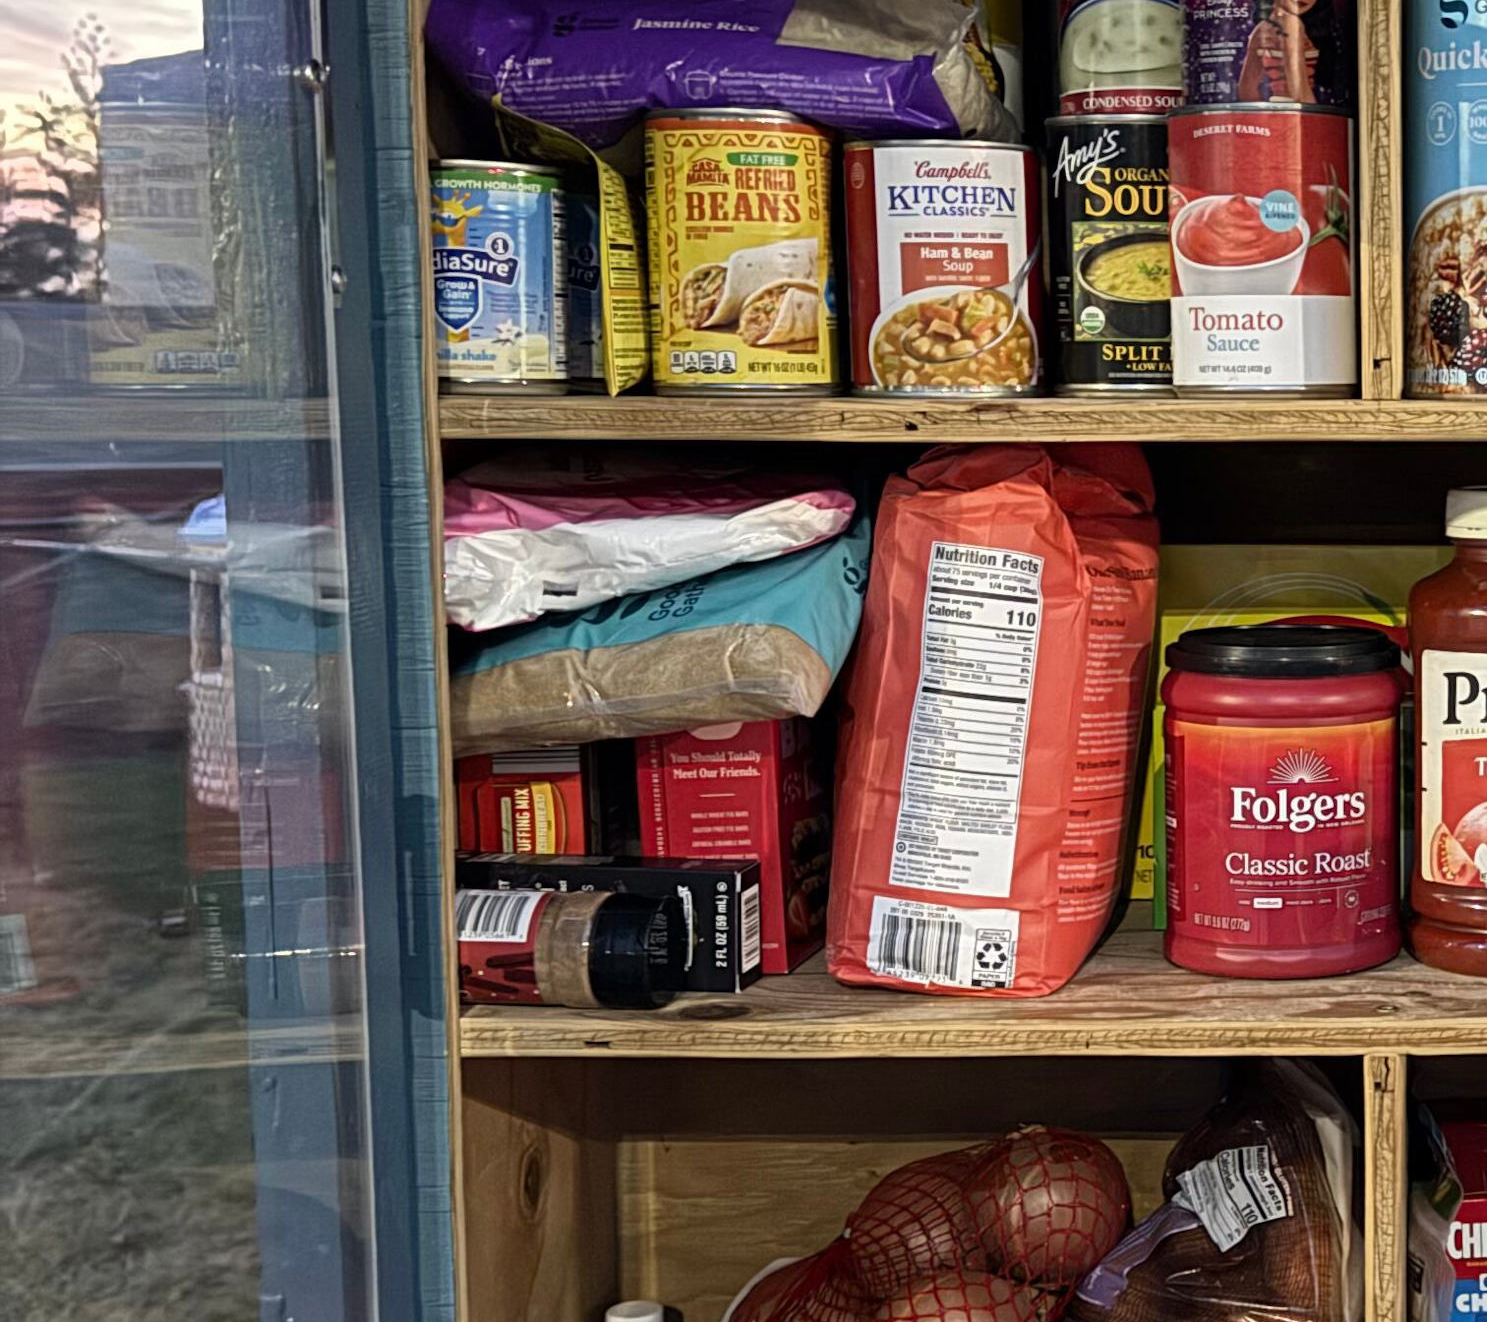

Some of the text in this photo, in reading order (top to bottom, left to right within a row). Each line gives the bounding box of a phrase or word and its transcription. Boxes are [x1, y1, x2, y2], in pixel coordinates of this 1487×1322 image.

[1193, 6, 1249, 20] PRINCESS
[632, 17, 761, 33] Jasmine Rice
[1083, 95, 1151, 110] CONDENSED
[1193, 124, 1271, 138] DESERET FARMS
[740, 154, 786, 166] FAT FREE
[1053, 128, 1123, 198] Amy's
[734, 168, 796, 192] REFRIED
[914, 161, 992, 182] Campbell's
[434, 179, 482, 189] GROWTH
[887, 185, 1017, 212] KITCHEN
[1265, 202, 1296, 212] VINE
[684, 191, 802, 224] BEANS
[922, 206, 988, 217] CLASSICS
[920, 246, 993, 259] Ham & Bean
[942, 260, 974, 273] Soup
[1189, 306, 1284, 331] Tomato
[1206, 333, 1261, 352] Sauce
[1102, 344, 1163, 361] SPLIT
[935, 546, 1039, 574] Nutrition Facts
[928, 603, 1036, 627] Calories 110
[673, 766, 761, 779] Meet Our Friends.
[1230, 786, 1366, 833] Folgers
[514, 788, 532, 853] UFFING MIX
[1225, 848, 1372, 876] Classic Roast
[715, 931, 728, 946] OZ
[715, 947, 728, 959] FL
[1218, 1150, 1259, 1225] Calories 110
